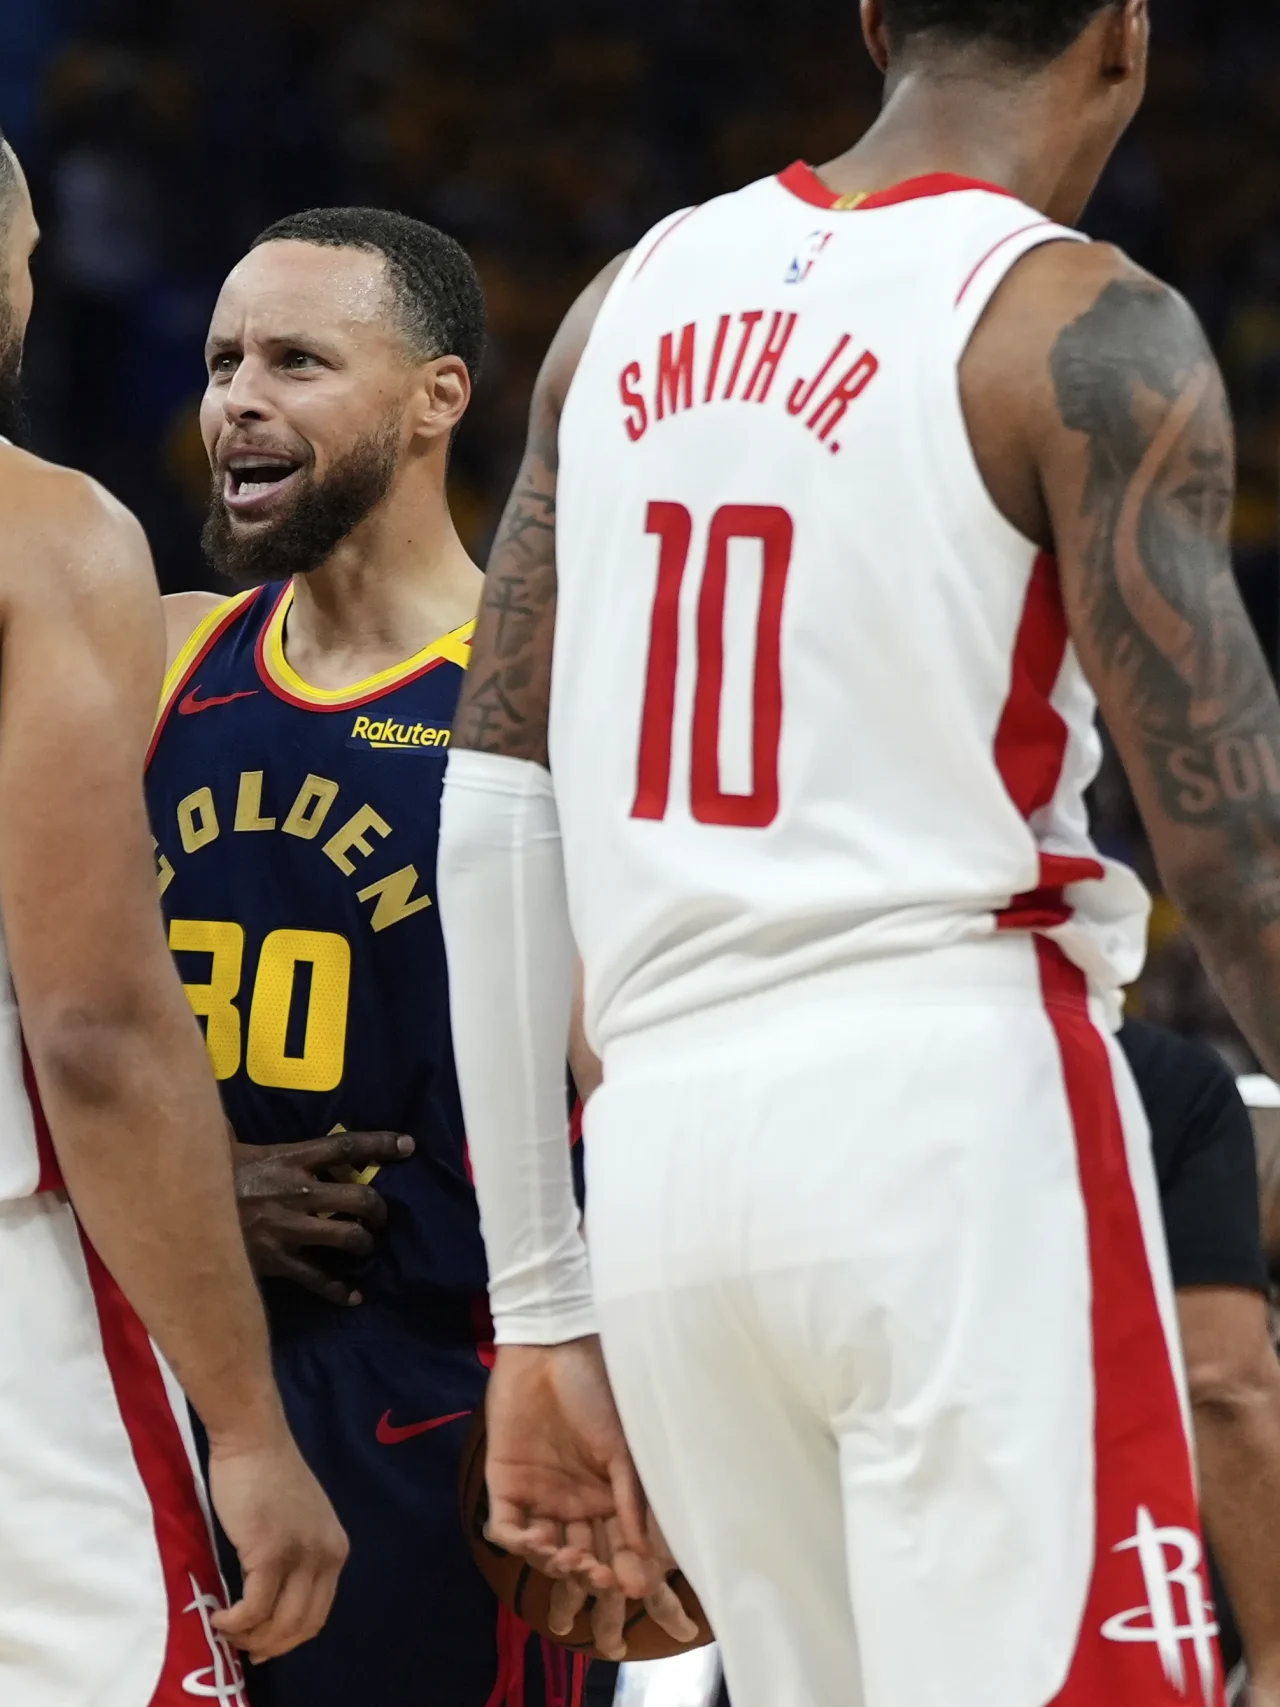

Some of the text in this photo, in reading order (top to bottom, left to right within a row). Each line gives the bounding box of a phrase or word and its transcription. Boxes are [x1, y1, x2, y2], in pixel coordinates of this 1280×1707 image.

[618, 310, 878, 454] SMITH JR.
[351, 715, 451, 747] Rakuten
[628, 500, 793, 828] 10
[168, 919, 351, 1092] 30
